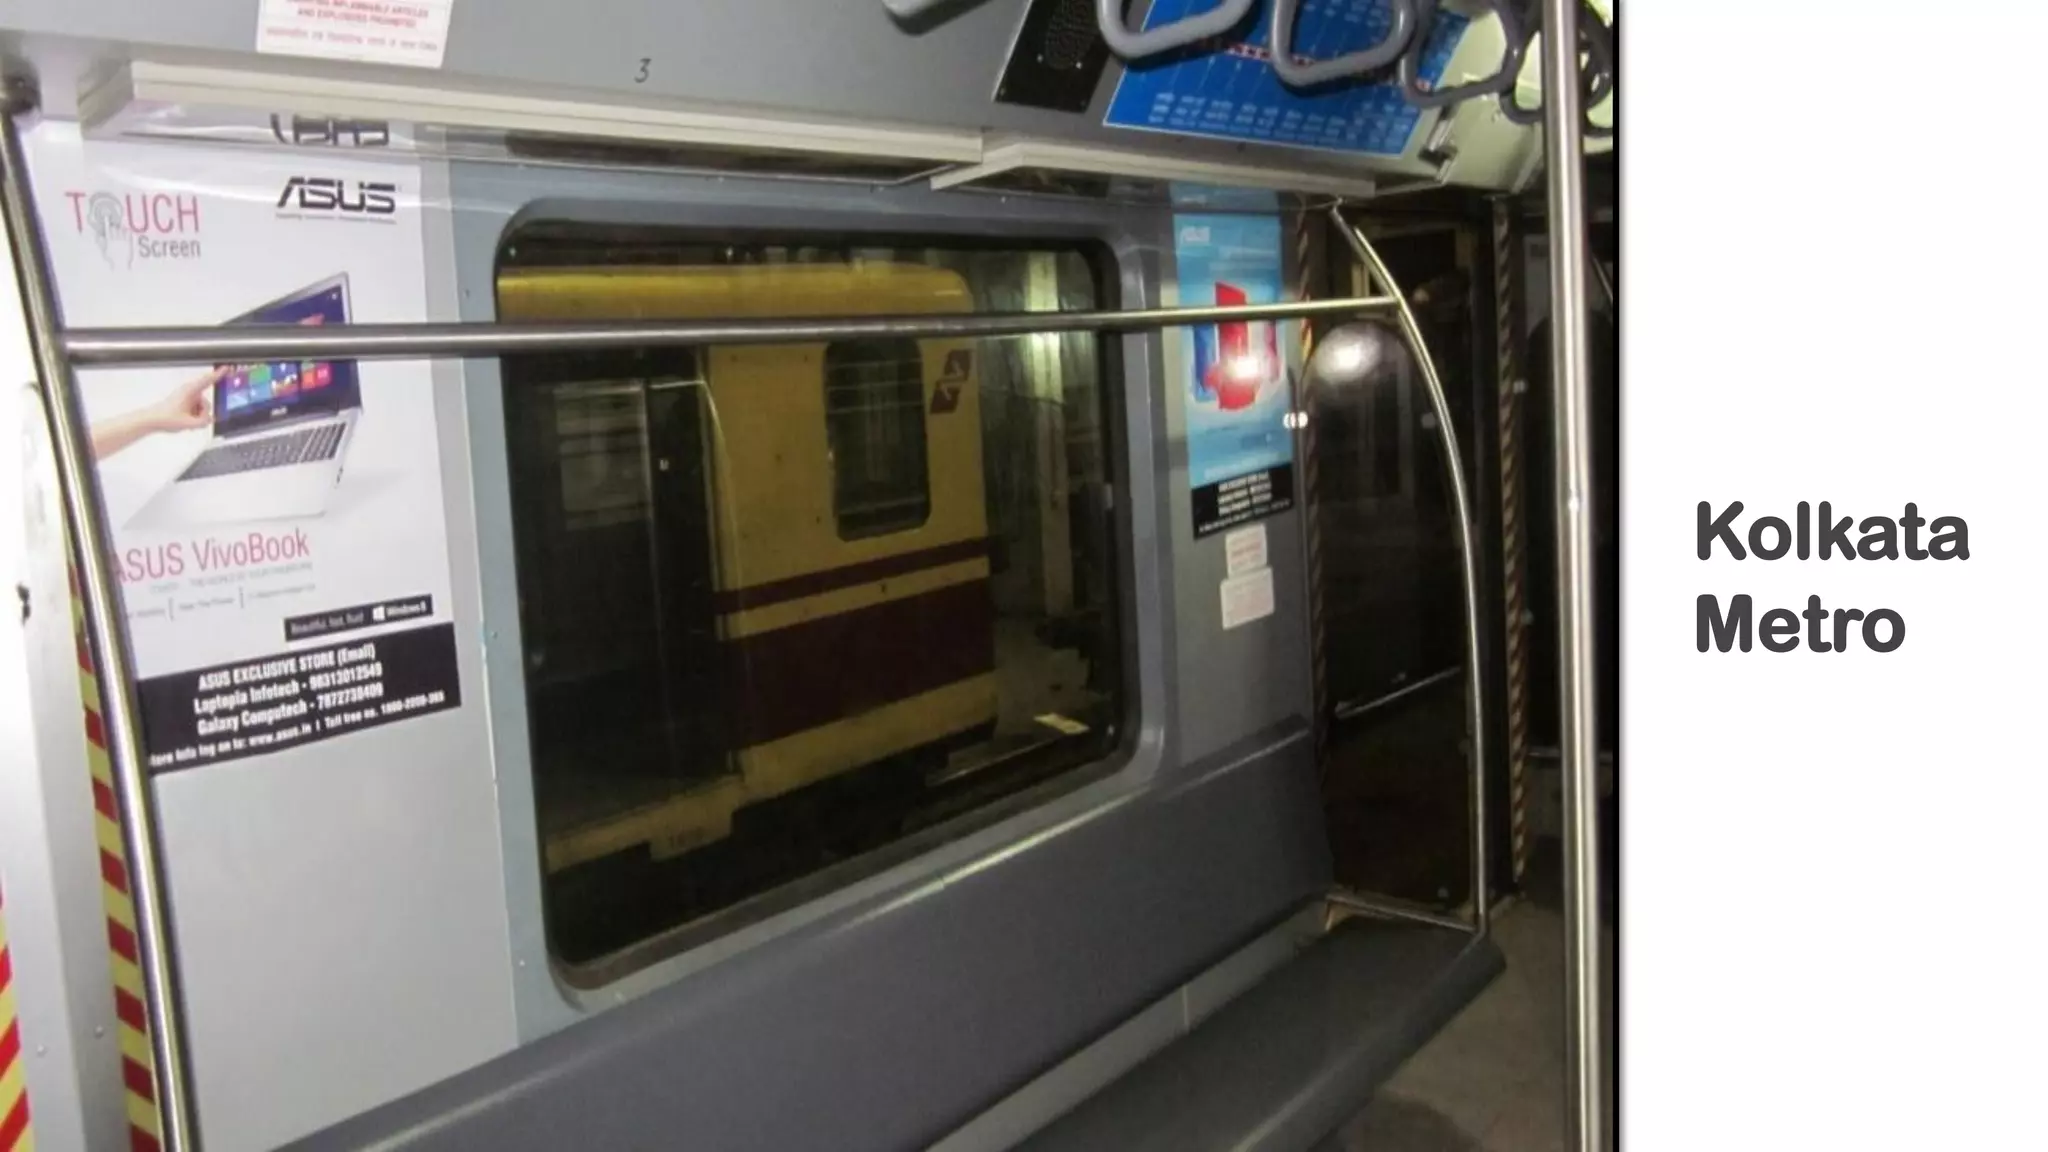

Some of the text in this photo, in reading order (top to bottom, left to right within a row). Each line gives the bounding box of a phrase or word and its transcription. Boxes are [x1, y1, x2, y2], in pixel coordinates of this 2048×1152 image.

[634, 58, 652, 83] 3
[64, 191, 200, 234] TOUCH
[277, 176, 396, 214] ASUS
[138, 236, 201, 259] Screen
[192, 527, 311, 572] VivoBook
[198, 670, 231, 692] ASUS
[233, 658, 297, 684] EXCLUSIVE
[299, 650, 335, 671] STORE
[194, 690, 248, 715] Laptopia
[250, 679, 300, 703] Infotech
[197, 715, 240, 736] Galaxy
[242, 698, 308, 726] Computech
